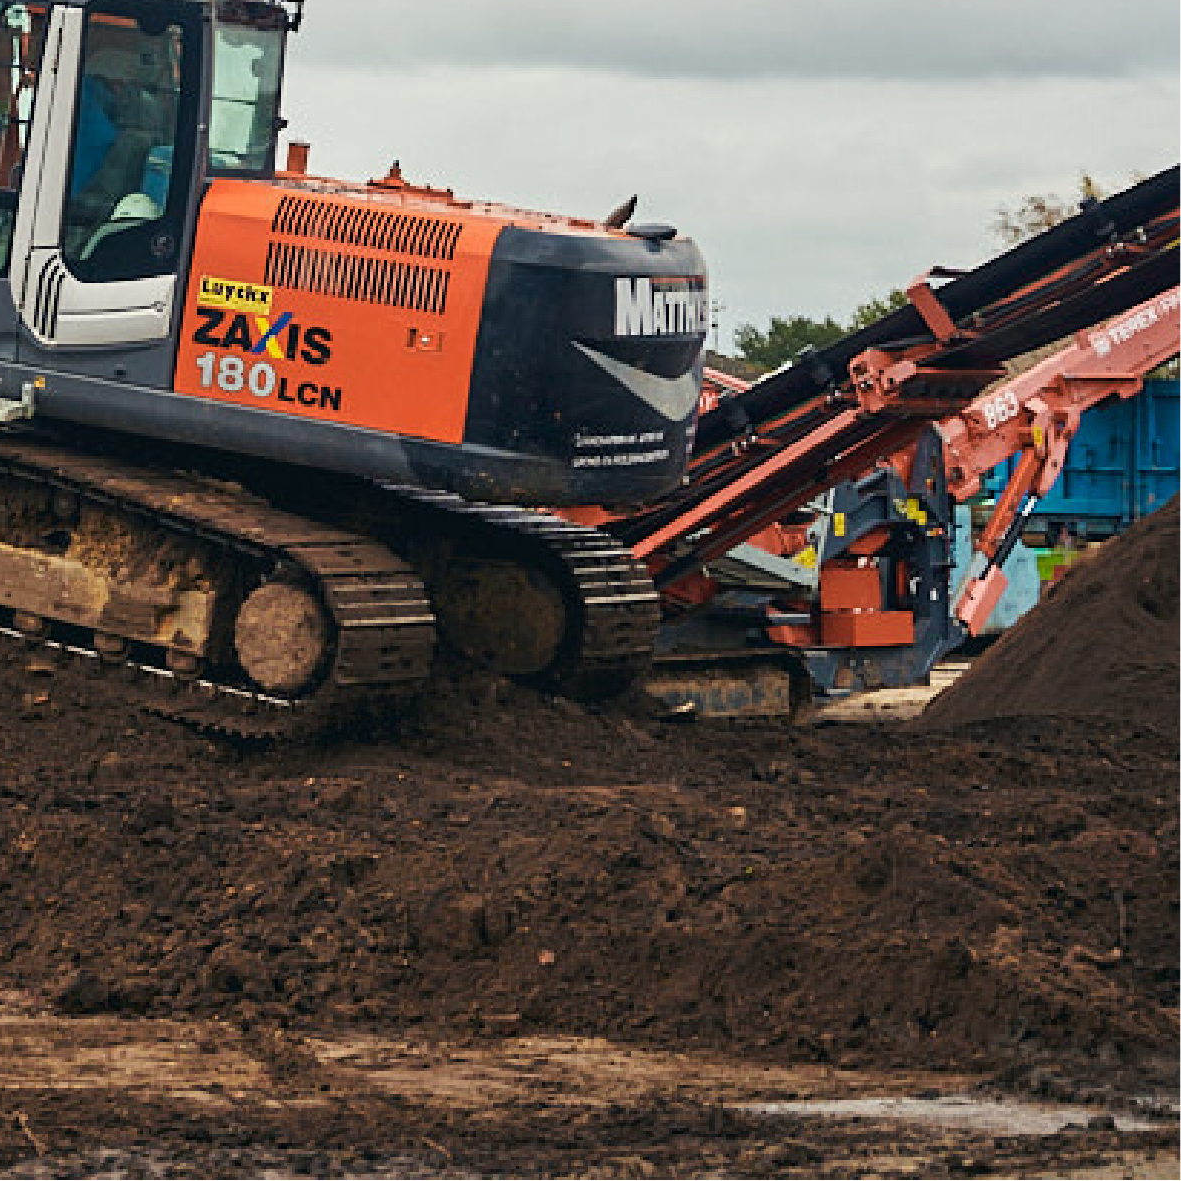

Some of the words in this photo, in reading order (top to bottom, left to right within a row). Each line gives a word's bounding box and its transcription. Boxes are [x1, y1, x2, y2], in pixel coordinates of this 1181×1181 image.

[194, 306, 333, 365] ZAXIS
[196, 351, 276, 397] 180
[278, 377, 342, 411] LCN
